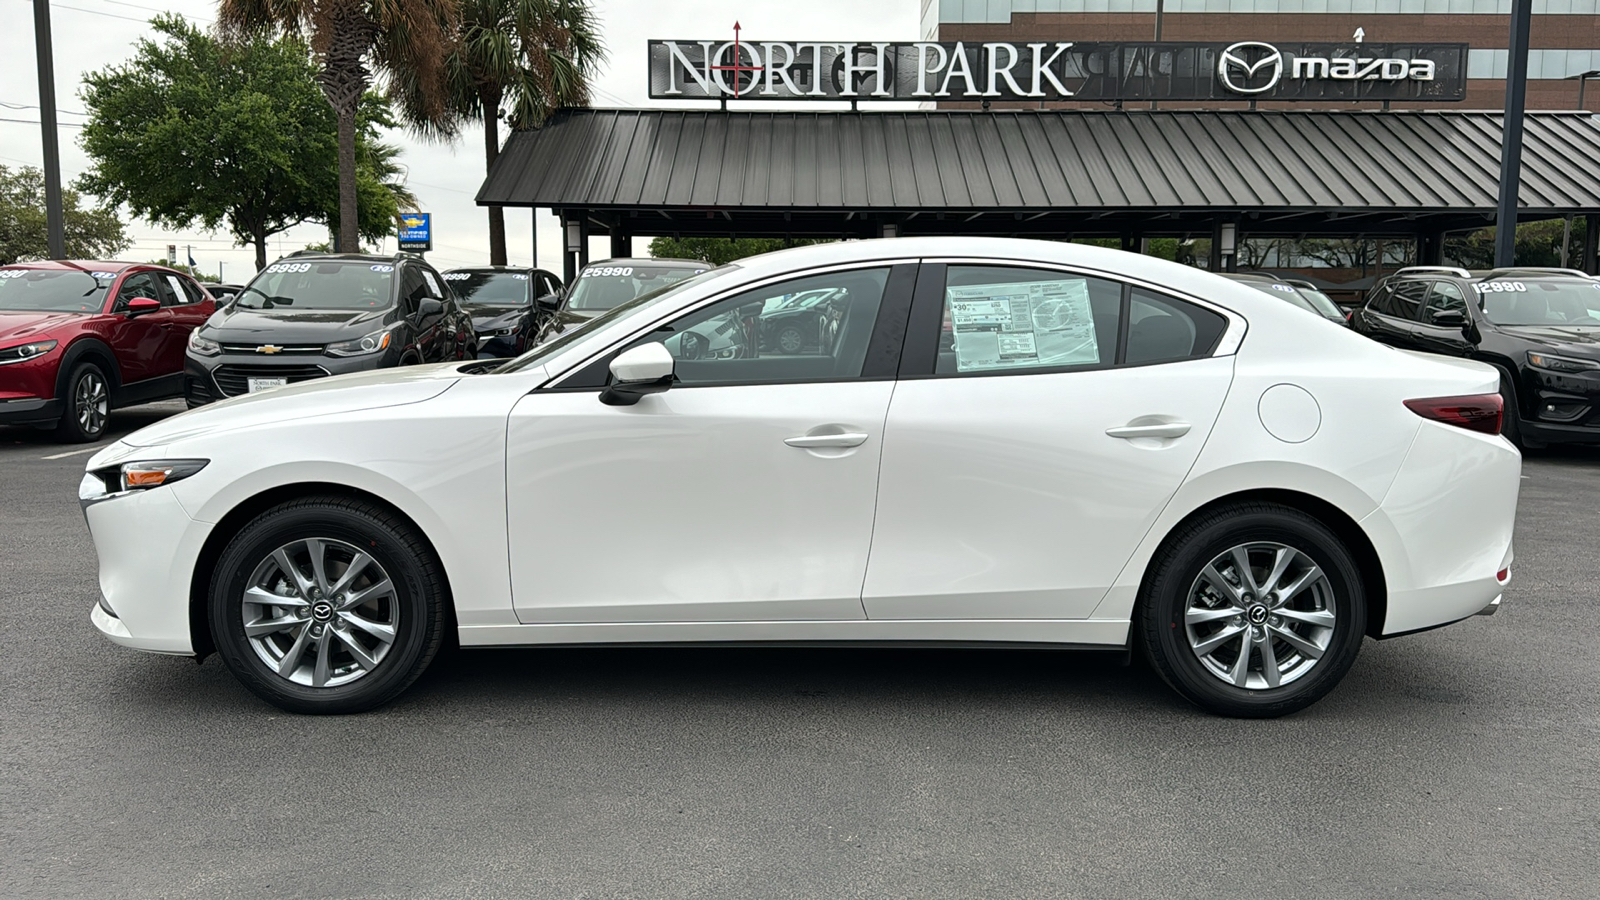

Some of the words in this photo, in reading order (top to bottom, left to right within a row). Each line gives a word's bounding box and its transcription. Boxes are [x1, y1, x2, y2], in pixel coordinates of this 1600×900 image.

[662, 40, 890, 97] NORTH
[911, 40, 1074, 97] PARK
[1292, 57, 1436, 81] mazda
[266, 263, 312, 274] 9999
[581, 267, 634, 278] 25990
[1471, 281, 1527, 294] 12990
